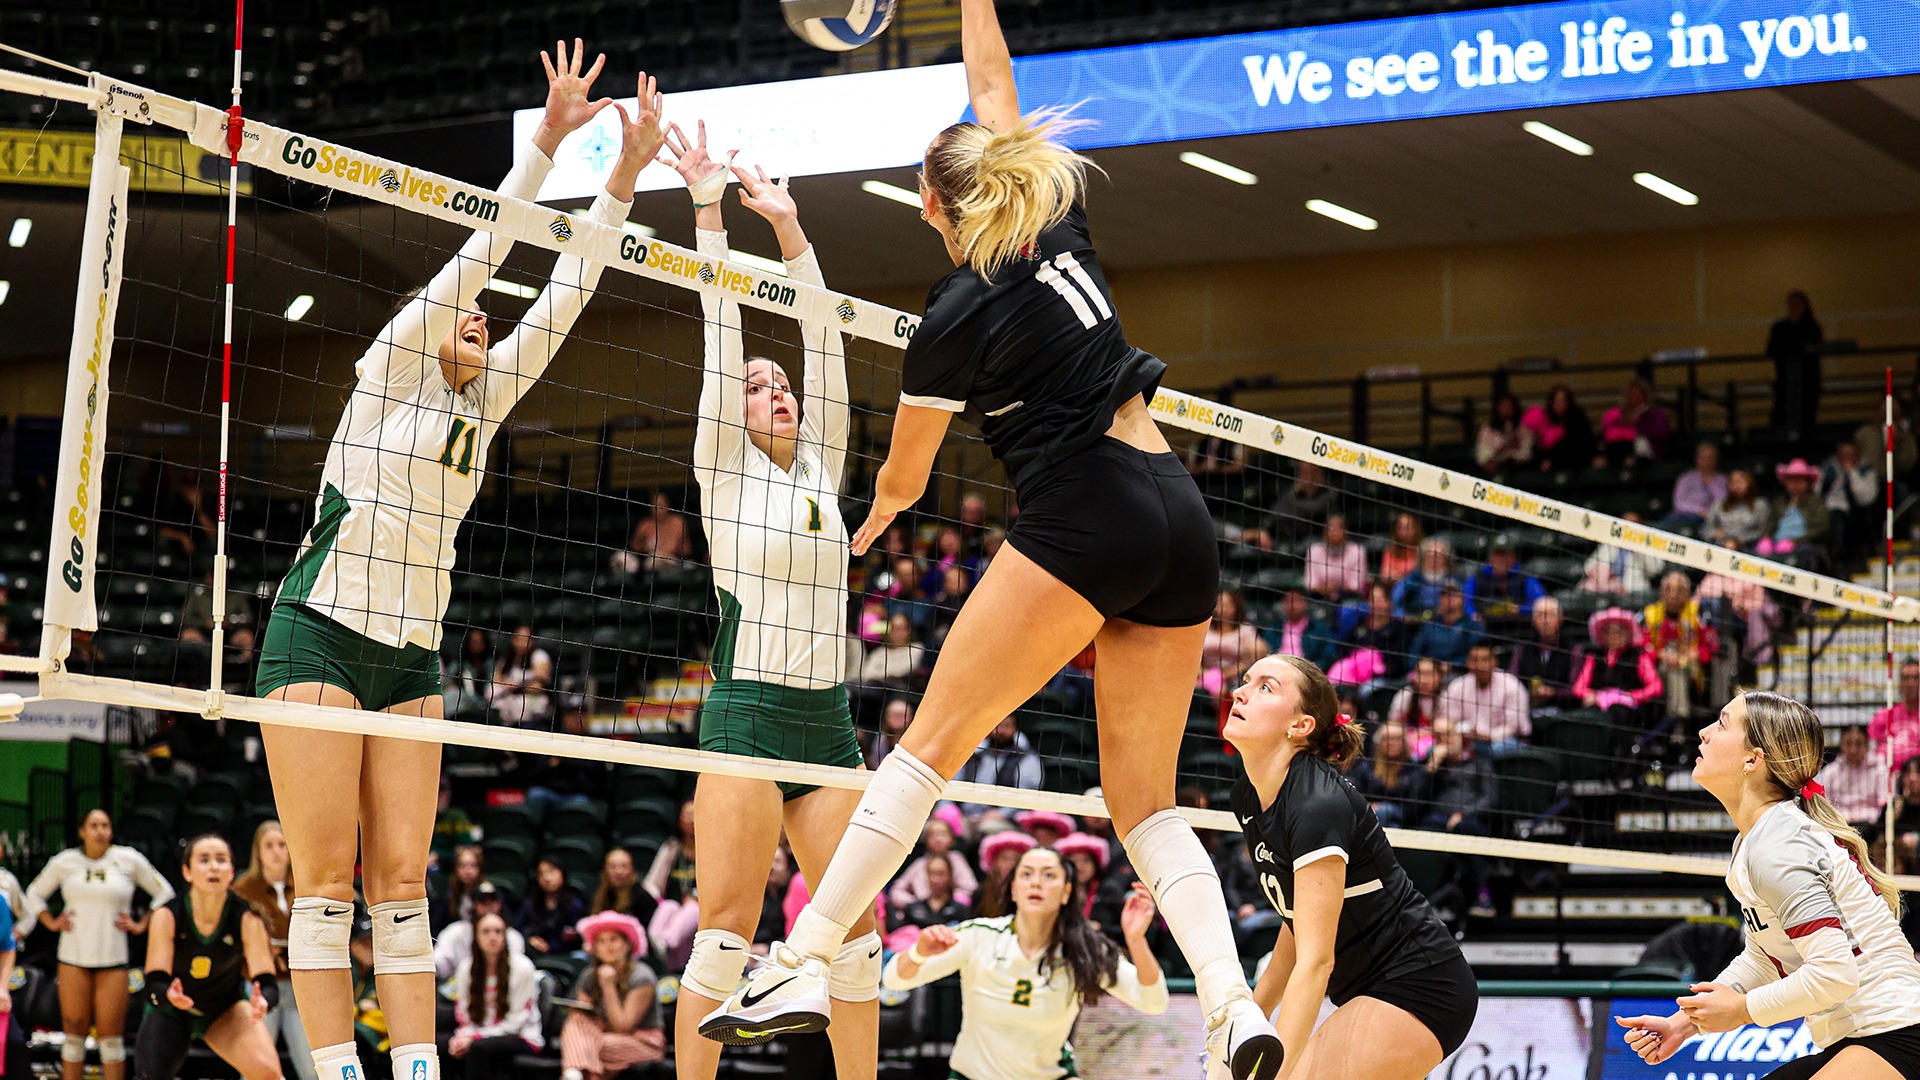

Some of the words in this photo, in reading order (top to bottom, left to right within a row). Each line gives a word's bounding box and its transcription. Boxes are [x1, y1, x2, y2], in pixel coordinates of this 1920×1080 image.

[1243, 51, 1332, 107] We
[1346, 51, 1440, 98] see
[1452, 30, 1549, 88] the
[1561, 17, 1653, 77] life
[1667, 11, 1729, 67] in
[1740, 12, 1868, 79] you.
[115, 85, 145, 100] Senoh
[1035, 251, 1113, 330] 11
[437, 415, 479, 479] 11
[804, 495, 824, 533] 1
[189, 955, 212, 980] 9
[1011, 978, 1033, 1008] 2
